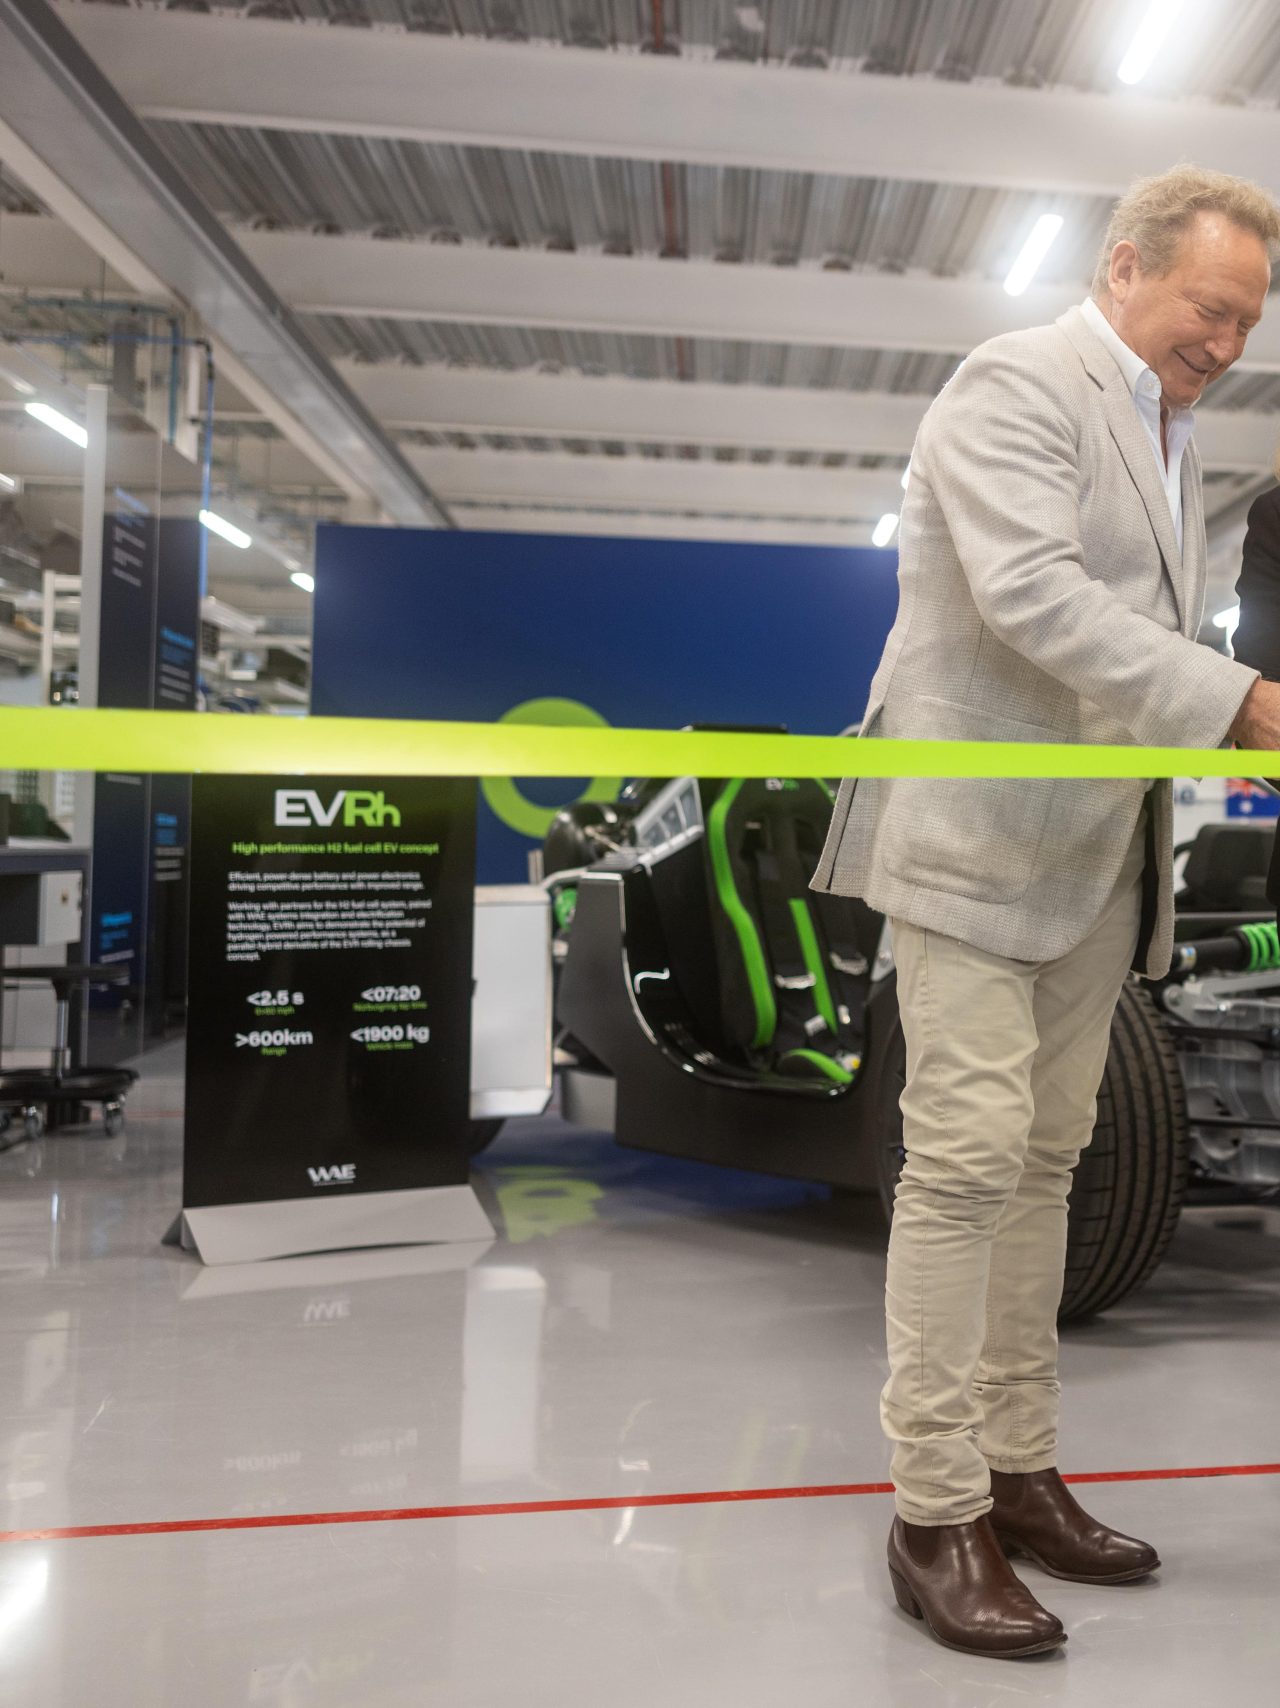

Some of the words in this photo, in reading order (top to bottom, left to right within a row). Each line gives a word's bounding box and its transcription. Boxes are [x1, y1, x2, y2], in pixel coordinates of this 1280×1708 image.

[274, 789, 401, 827] EVRh
[232, 841, 258, 855] High
[260, 841, 325, 855] performance
[327, 841, 342, 854] H2
[343, 841, 363, 854] fuel
[364, 841, 382, 854] cell
[383, 841, 399, 854] EV
[399, 841, 439, 856] concept
[341, 870, 356, 881] and
[357, 871, 380, 882] power
[228, 881, 256, 893] driving
[227, 901, 261, 913] Working
[247, 989, 289, 1006] <2.5
[292, 991, 305, 1006] s
[361, 984, 422, 1002] <07:20
[234, 1028, 313, 1048] >600km
[350, 1026, 404, 1043] <1900
[405, 1023, 430, 1044] kg
[307, 1163, 357, 1182] WAE
